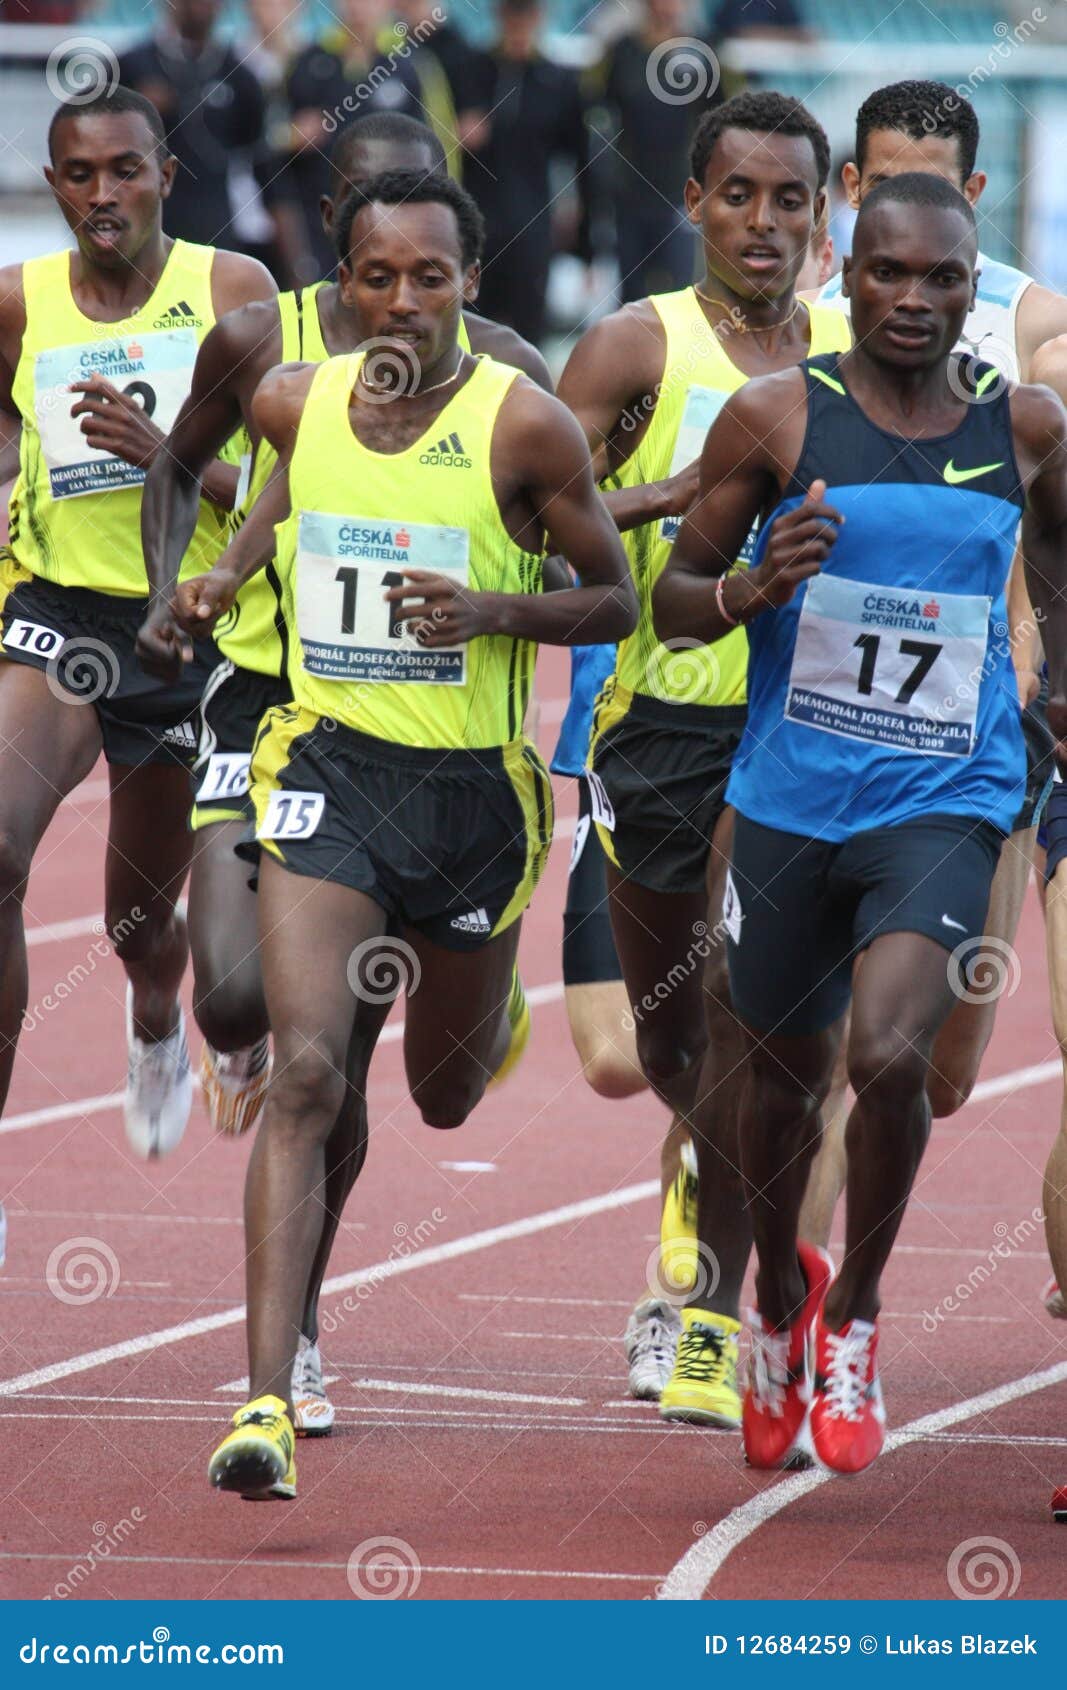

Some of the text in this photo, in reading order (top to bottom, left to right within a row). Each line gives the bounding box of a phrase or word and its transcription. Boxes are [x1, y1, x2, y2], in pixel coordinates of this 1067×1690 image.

[153, 313, 203, 329] adidas
[104, 460, 138, 475] JOSE
[419, 452, 472, 469] adidas
[85, 475, 124, 488] Premium
[338, 523, 393, 546] ČESKÁ
[337, 543, 409, 561] SPOŘITELNA
[863, 592, 920, 616] ČESKÁ
[861, 612, 936, 632] SPOŘITELNA
[18, 626, 57, 653] 10
[323, 660, 365, 675] Premium
[852, 633, 943, 705] 17
[792, 692, 859, 721] MEMORIÁL
[861, 711, 905, 731] JOSEFA
[813, 711, 945, 749] EAA Premium Meeting 2009
[213, 762, 249, 795] 16
[272, 798, 317, 835] 15
[450, 919, 491, 933] adidas
